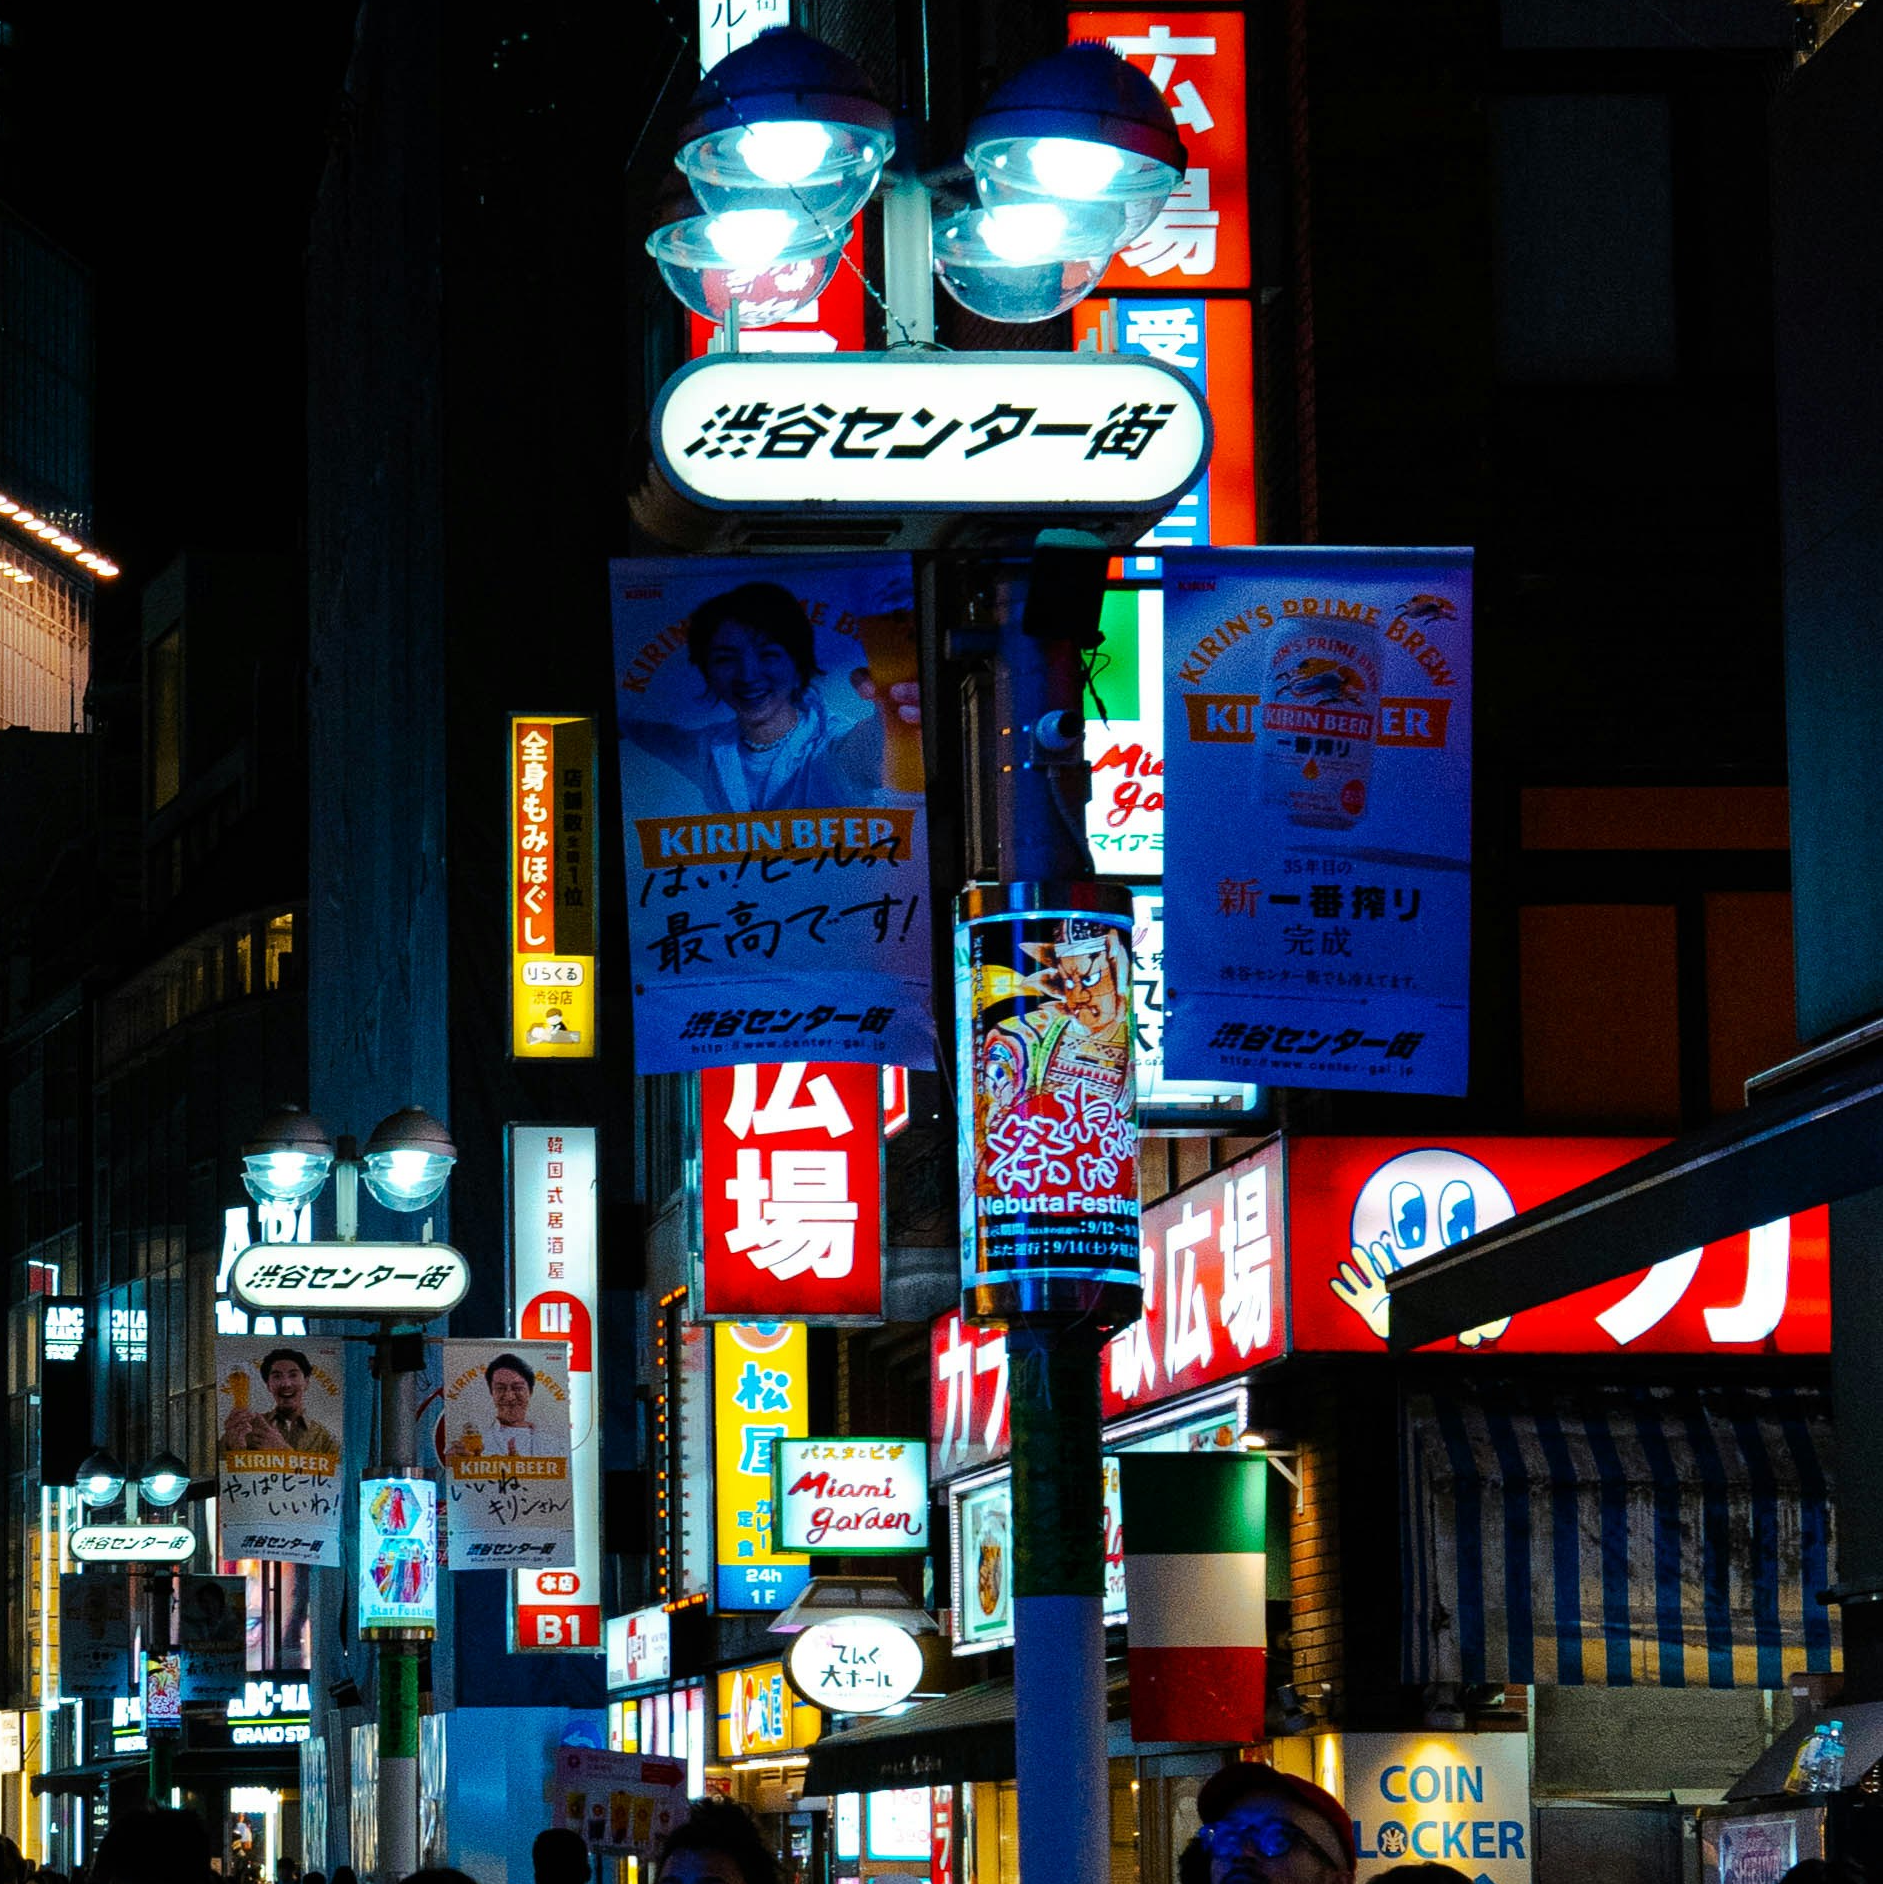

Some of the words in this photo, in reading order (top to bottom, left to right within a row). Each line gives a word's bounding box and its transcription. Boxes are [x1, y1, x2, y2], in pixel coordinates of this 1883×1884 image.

[684, 402, 1179, 460] 渋谷センター街
[1179, 606, 1275, 686] KIRIN'S
[520, 730, 549, 946] 全身もみほぐし
[660, 820, 781, 857] KIRIN
[1283, 925, 1352, 956] 完成
[526, 966, 578, 981] りらくる
[532, 990, 573, 1005] 渋谷店
[680, 1006, 895, 1040] 渋谷センター街
[1210, 1022, 1424, 1058] 渋谷センター街
[547, 1136, 564, 1280] 韓国式居酒屋
[978, 1195, 1065, 1217] Nebuta
[246, 1265, 455, 1290] 渋谷センター街
[234, 1454, 285, 1470] KIRIN
[289, 1455, 329, 1472] BEER
[802, 1444, 905, 1461] パスタとピザ
[460, 1459, 512, 1475] KIRIN
[515, 1459, 559, 1475] BEER
[789, 1470, 896, 1500] Miami
[78, 1536, 188, 1550] 渋谷センター街
[241, 1536, 324, 1553] 渋谷センター街
[466, 1542, 556, 1556] 渋谷センター街
[540, 1574, 576, 1592] 本店
[746, 1567, 783, 1584] 24h
[751, 1589, 776, 1604] 1F
[536, 1614, 581, 1646] B1
[820, 1664, 893, 1689] 大ホール
[1380, 1766, 1484, 1804] COIN
